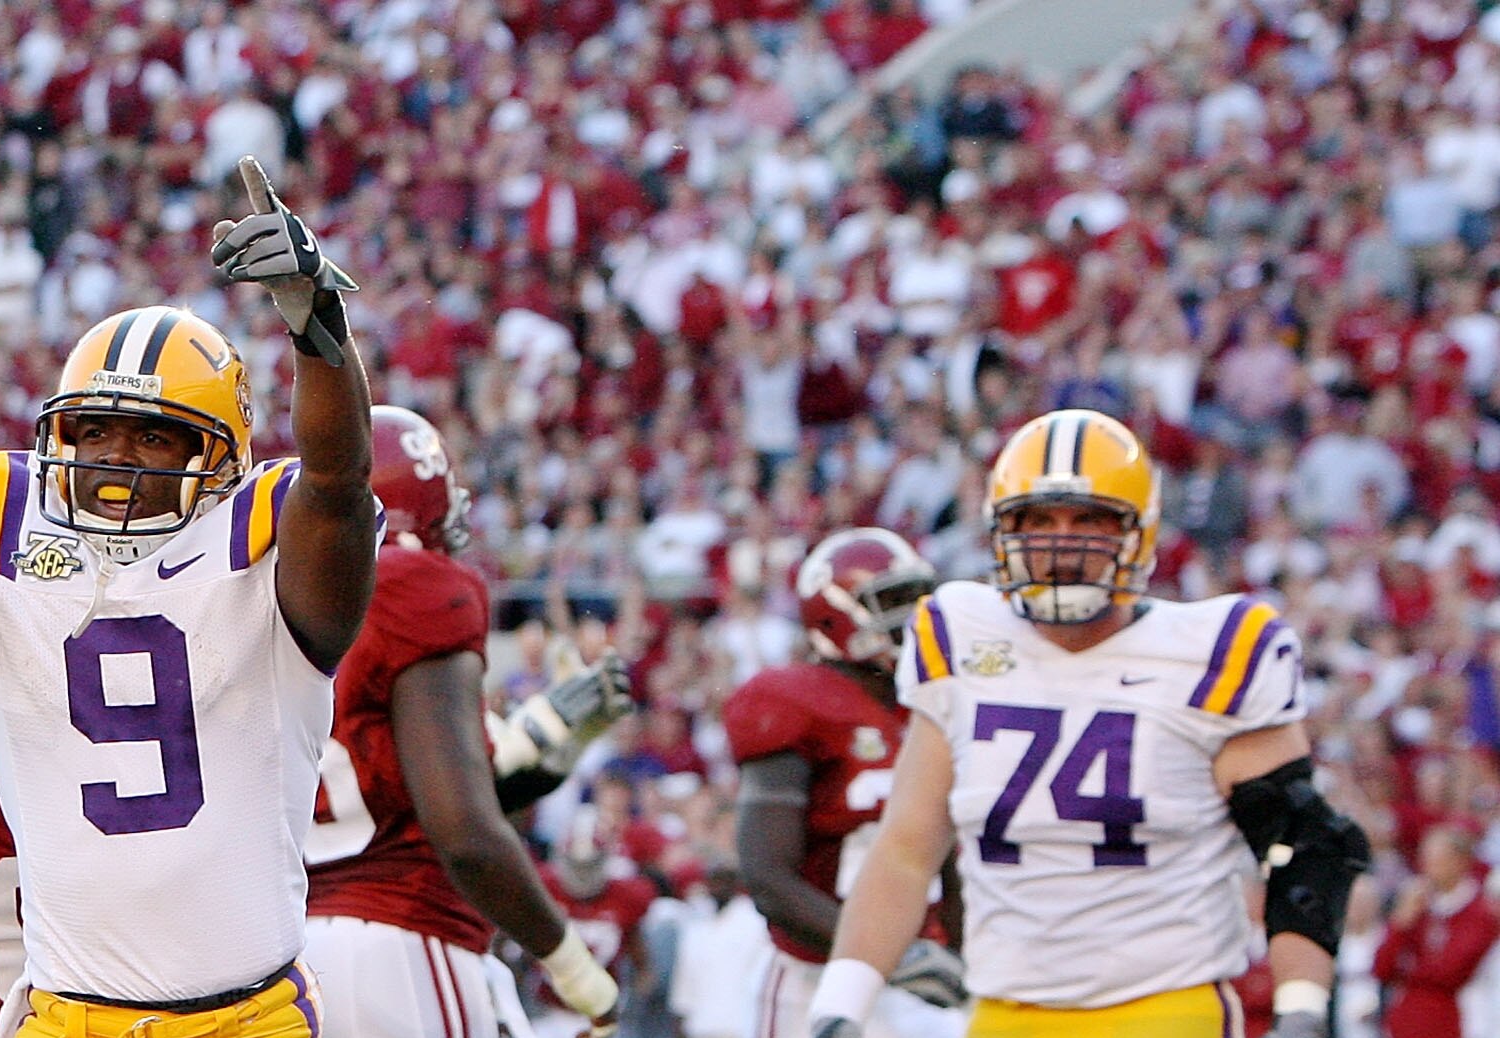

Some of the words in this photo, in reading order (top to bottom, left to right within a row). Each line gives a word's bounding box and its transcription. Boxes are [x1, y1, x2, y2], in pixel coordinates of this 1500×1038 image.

[107, 375, 141, 389] TIGERS
[34, 549, 64, 579] SEC
[64, 614, 205, 835] 9
[973, 703, 1147, 866] 74
